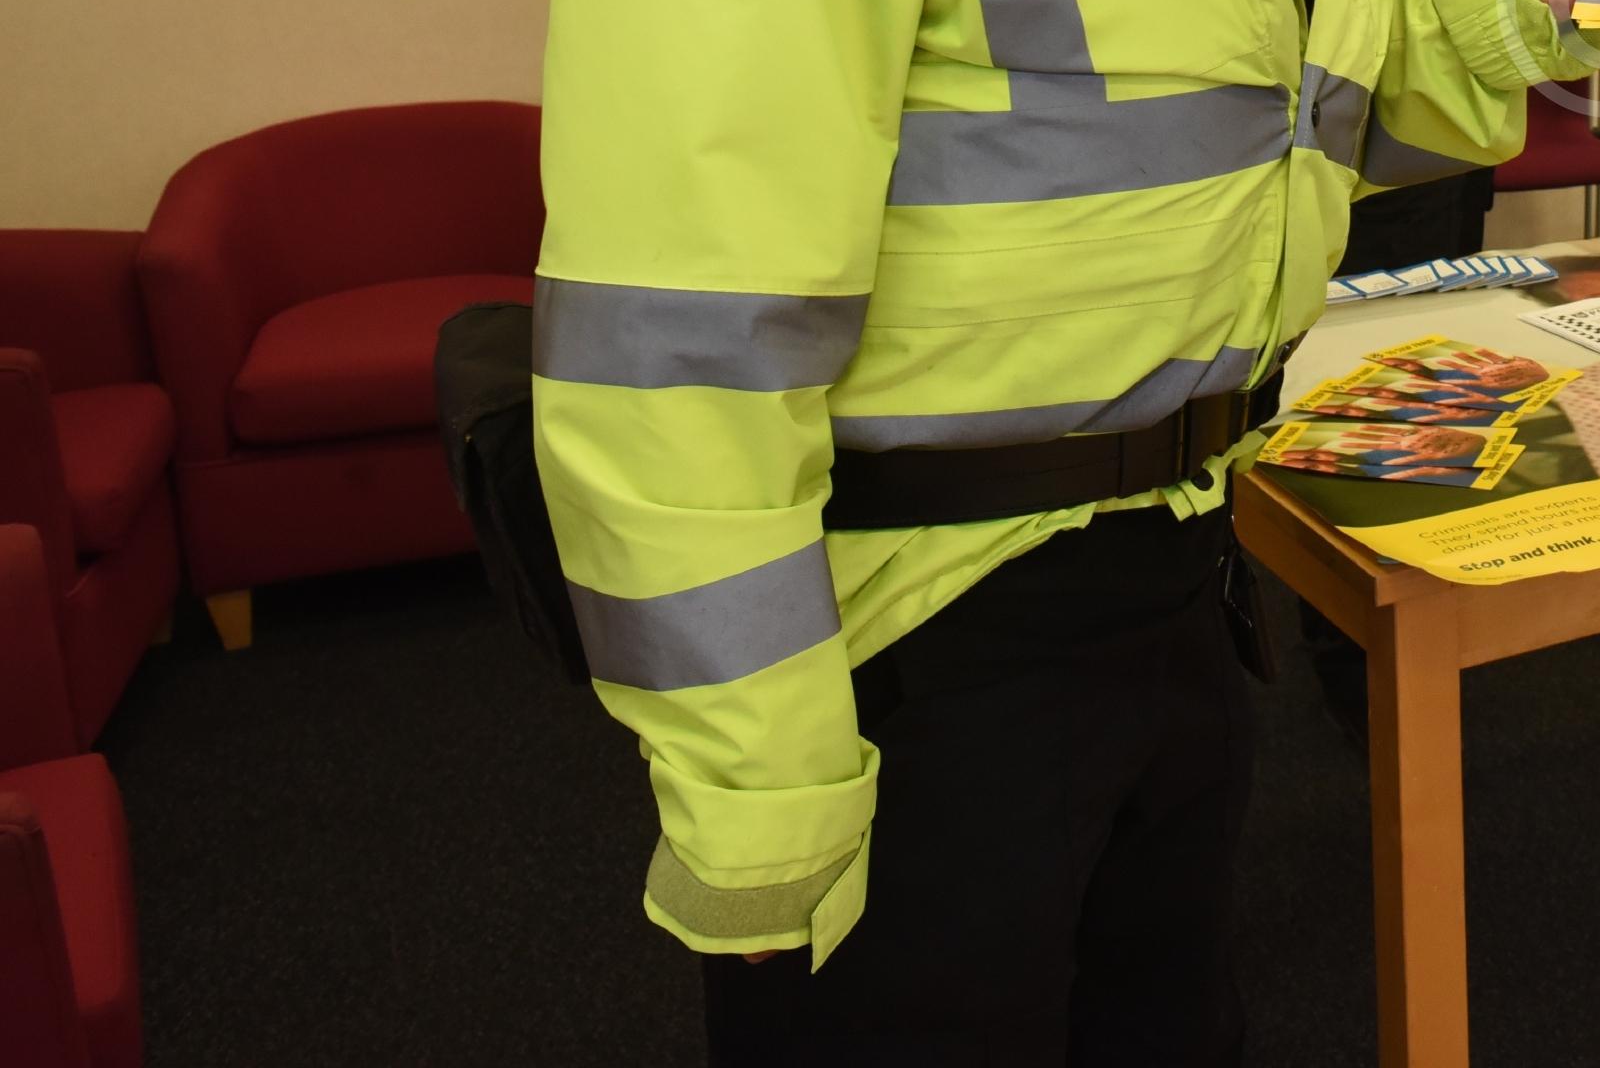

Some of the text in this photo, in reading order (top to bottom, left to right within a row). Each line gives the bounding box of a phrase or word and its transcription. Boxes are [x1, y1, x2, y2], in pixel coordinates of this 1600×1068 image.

[1419, 515, 1499, 539] Criminals
[1505, 508, 1531, 520] are
[1534, 494, 1600, 514] experts
[1430, 532, 1472, 549] They
[1476, 518, 1529, 537] spend
[1532, 507, 1579, 523] hours
[1442, 538, 1493, 556] down
[1495, 529, 1522, 544] for
[1526, 522, 1558, 538] just
[1562, 519, 1573, 529] a
[1459, 556, 1506, 575] Stop
[1509, 546, 1545, 563] and
